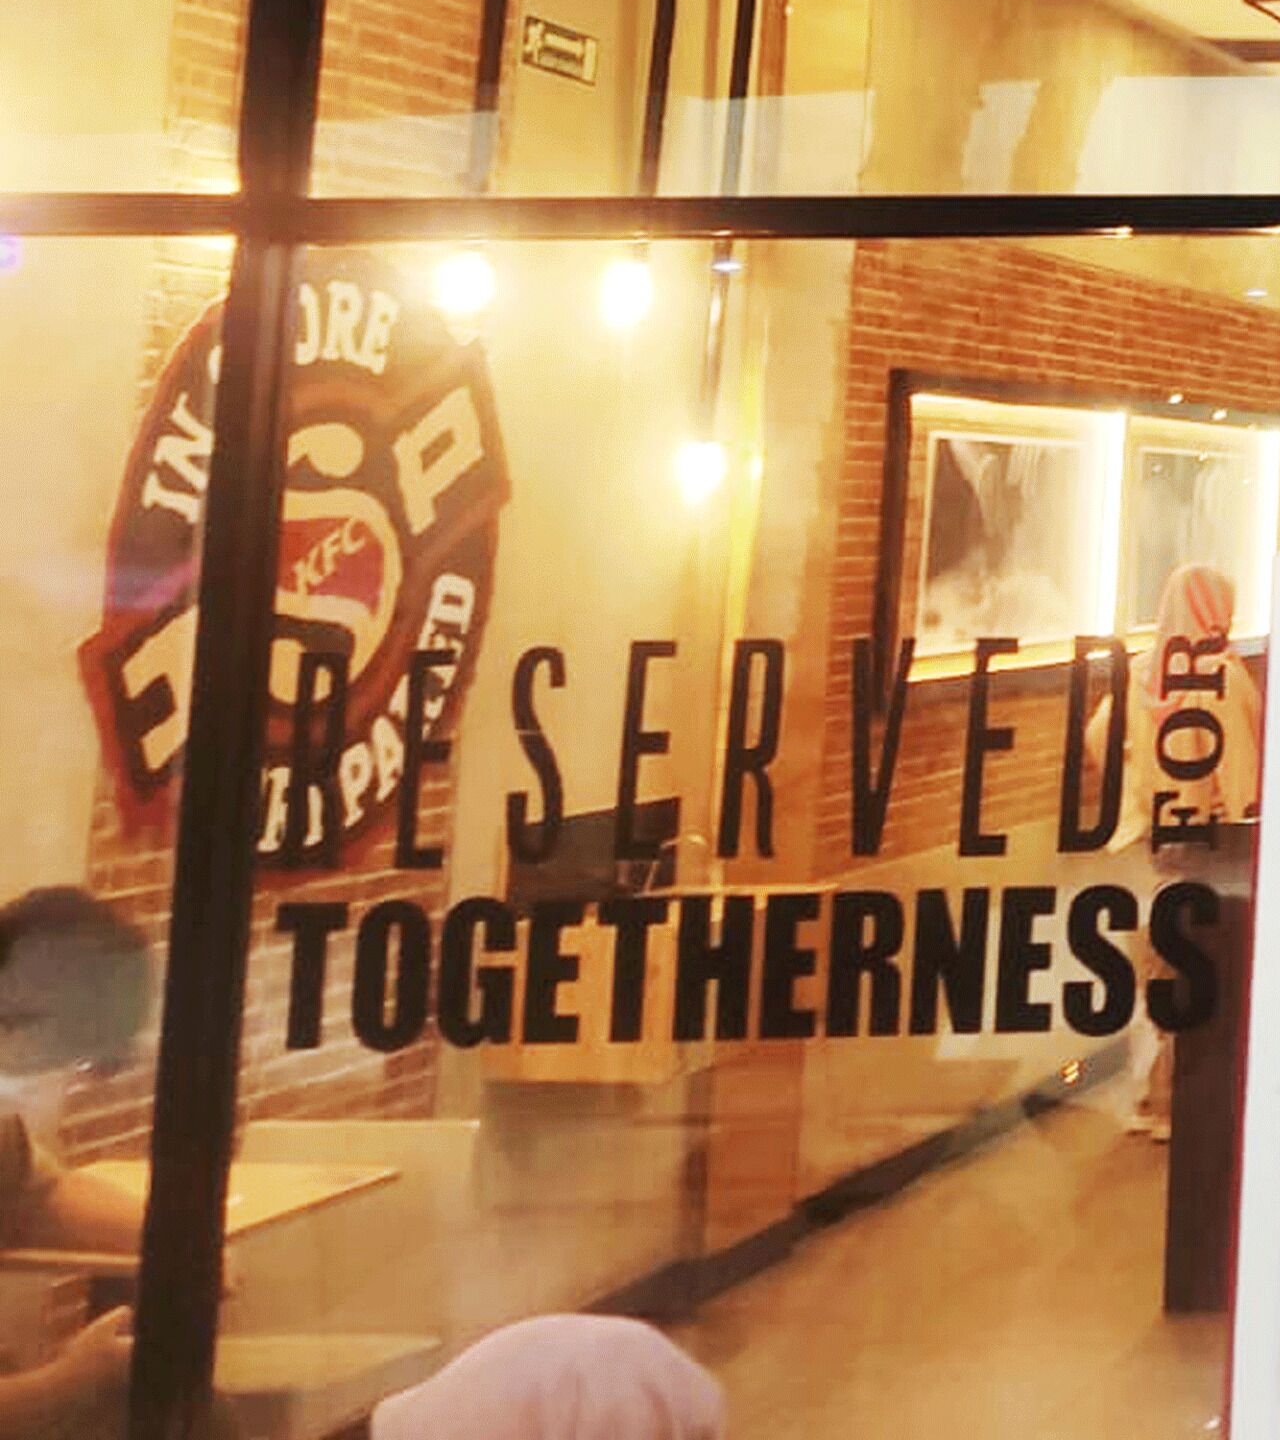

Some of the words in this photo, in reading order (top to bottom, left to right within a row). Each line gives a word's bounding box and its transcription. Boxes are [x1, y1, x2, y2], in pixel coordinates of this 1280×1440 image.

[292, 516, 367, 596] KFC
[279, 636, 1130, 870] RESERVED
[1152, 623, 1228, 852] FOR
[275, 881, 1223, 1052] TOGETHERNESS
